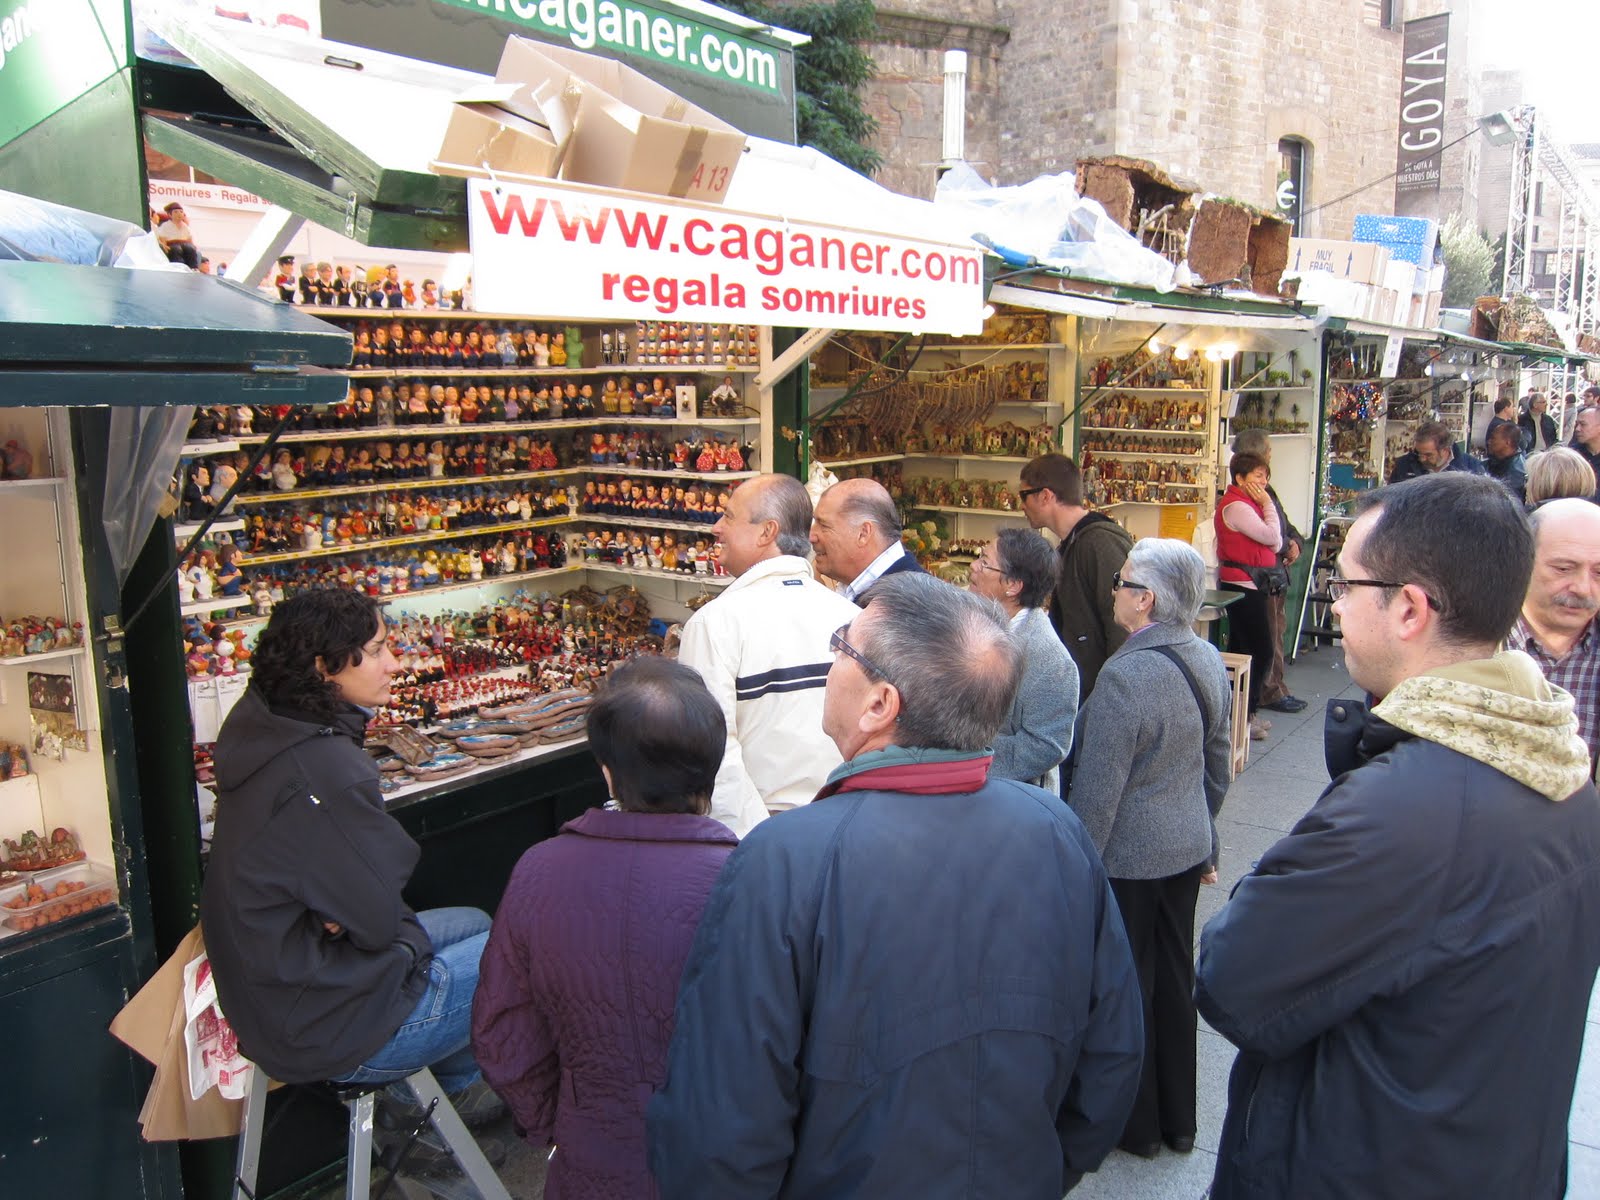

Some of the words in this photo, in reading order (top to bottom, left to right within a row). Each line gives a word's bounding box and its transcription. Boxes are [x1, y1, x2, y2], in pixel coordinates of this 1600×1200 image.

[1401, 42, 1446, 151] GOYA
[689, 163, 704, 189] A
[707, 166, 729, 192] 13
[1397, 172, 1425, 183] NUESTROS
[149, 183, 211, 199] Somriures
[221, 190, 258, 204] Regala
[480, 190, 979, 285] www.caganer.com
[1316, 249, 1333, 260] MUY
[602, 272, 746, 314] regala
[761, 285, 926, 320] somriures
